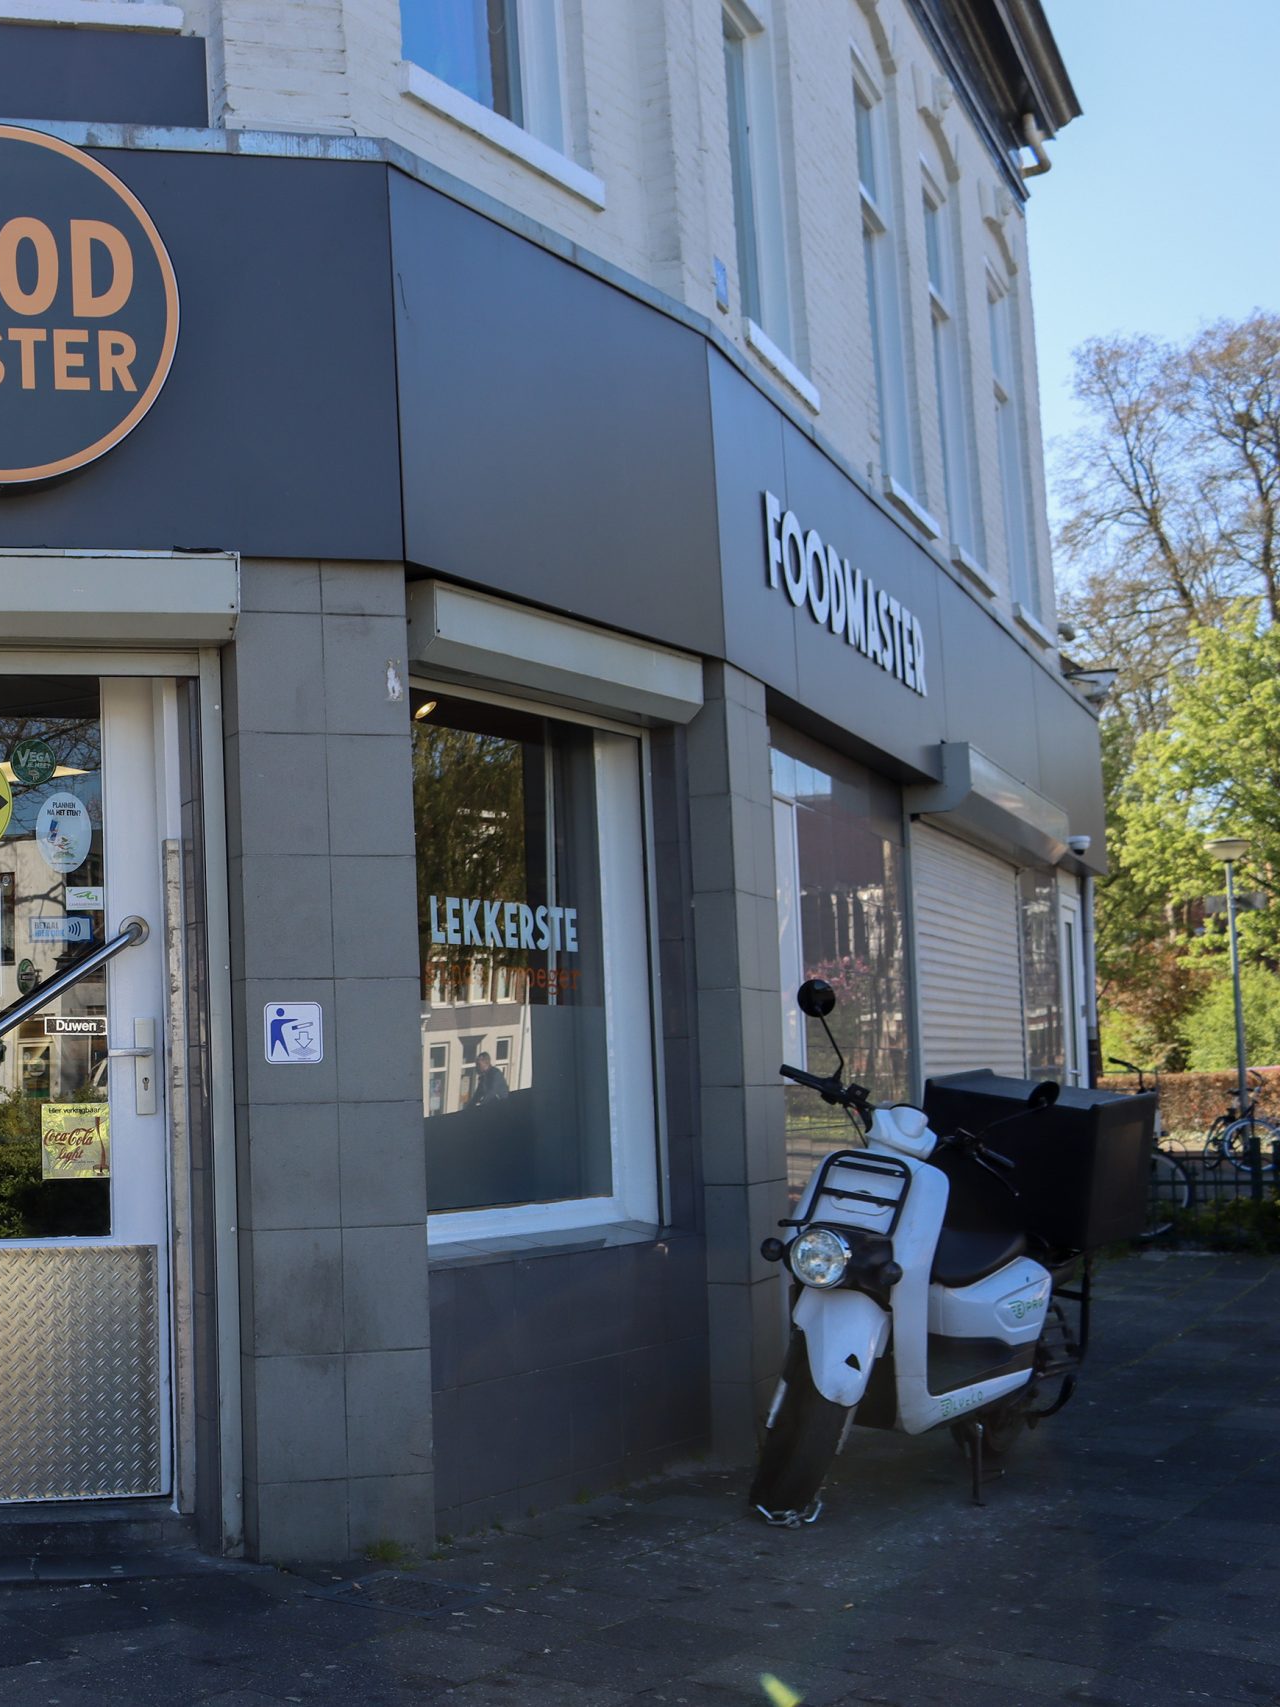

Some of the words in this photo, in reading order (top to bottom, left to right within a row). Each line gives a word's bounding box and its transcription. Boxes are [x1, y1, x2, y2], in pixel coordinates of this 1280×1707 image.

[764, 489, 928, 698] FOODMASTER
[52, 801, 76, 809] PLANNEN
[429, 895, 579, 953] LEKKERSTE
[56, 1019, 97, 1031] Duwen
